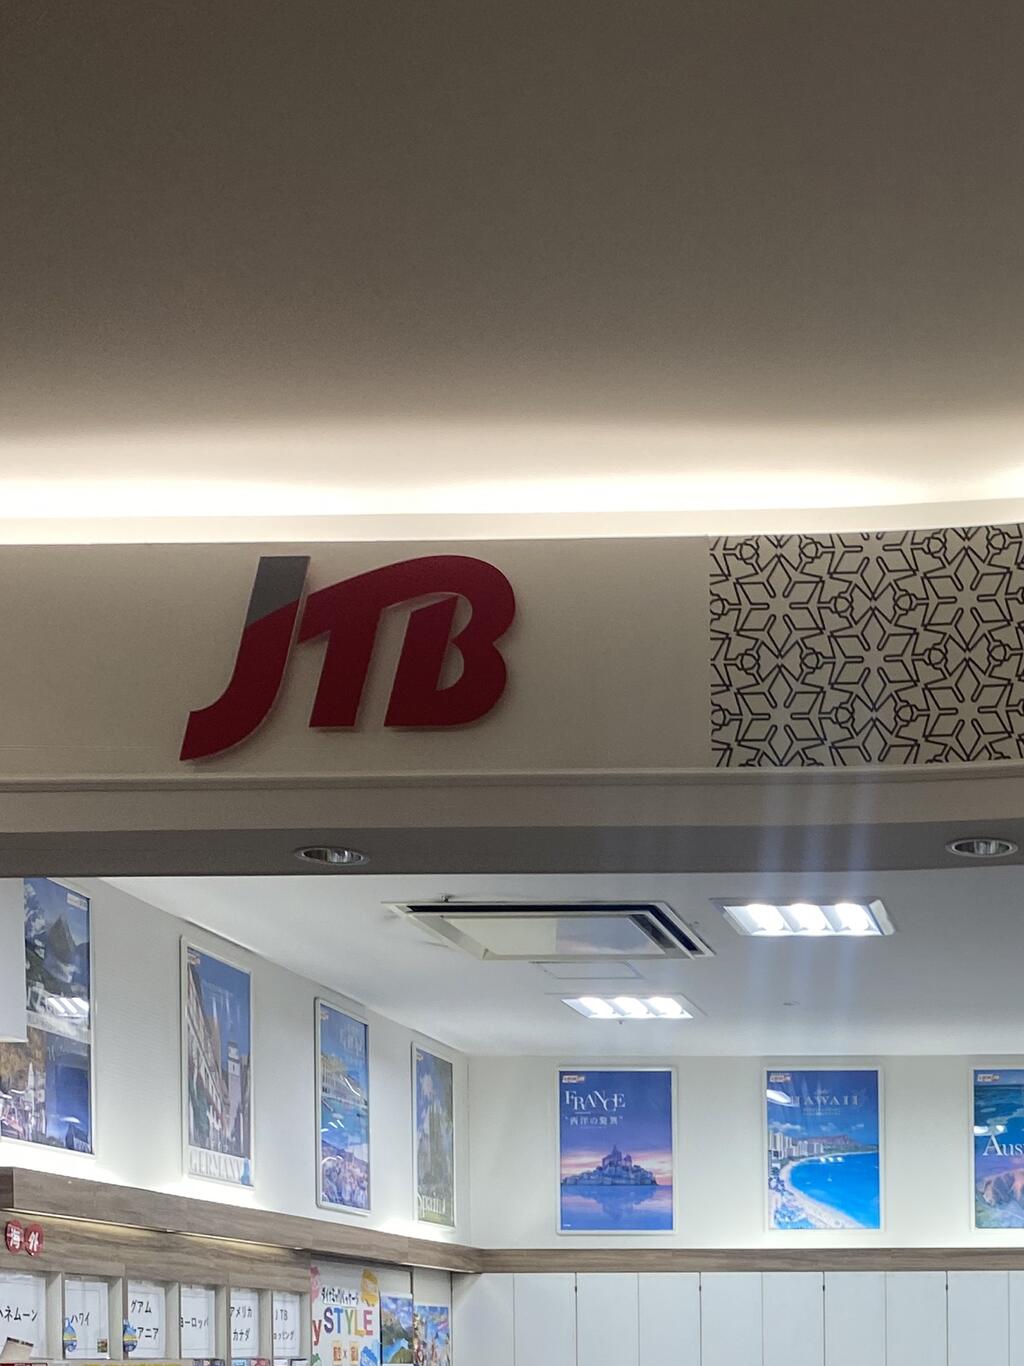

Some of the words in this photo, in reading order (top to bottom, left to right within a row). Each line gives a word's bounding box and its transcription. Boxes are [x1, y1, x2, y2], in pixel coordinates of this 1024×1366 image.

[179, 554, 516, 762] JTB
[565, 1090, 626, 1112] FRANCE
[7, 1223, 42, 1254] 海外
[131, 1300, 152, 1314] グアム
[71, 1312, 90, 1327] ハワイ
[232, 1328, 250, 1341] カナダ
